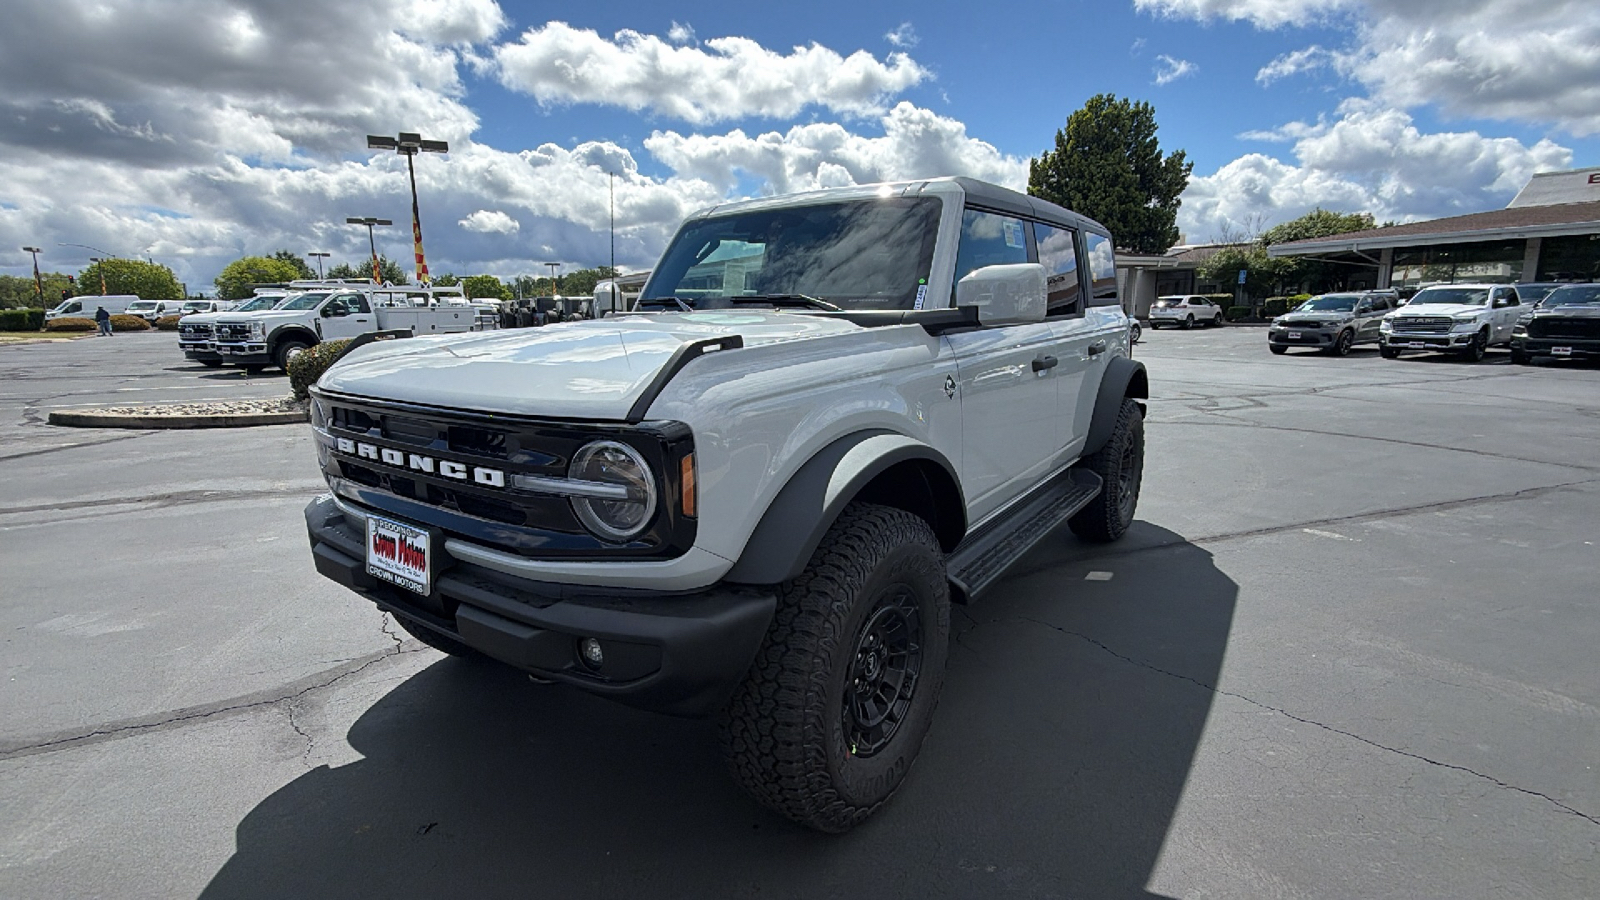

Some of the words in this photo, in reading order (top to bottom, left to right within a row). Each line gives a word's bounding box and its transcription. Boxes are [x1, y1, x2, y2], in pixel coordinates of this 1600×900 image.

[337, 437, 505, 487] BRONCO
[379, 520, 412, 536] REDDING
[372, 531, 396, 561] Crown
[398, 533, 426, 573] Motors
[369, 566, 394, 582] CROWN
[394, 574, 423, 593] MOTORS
